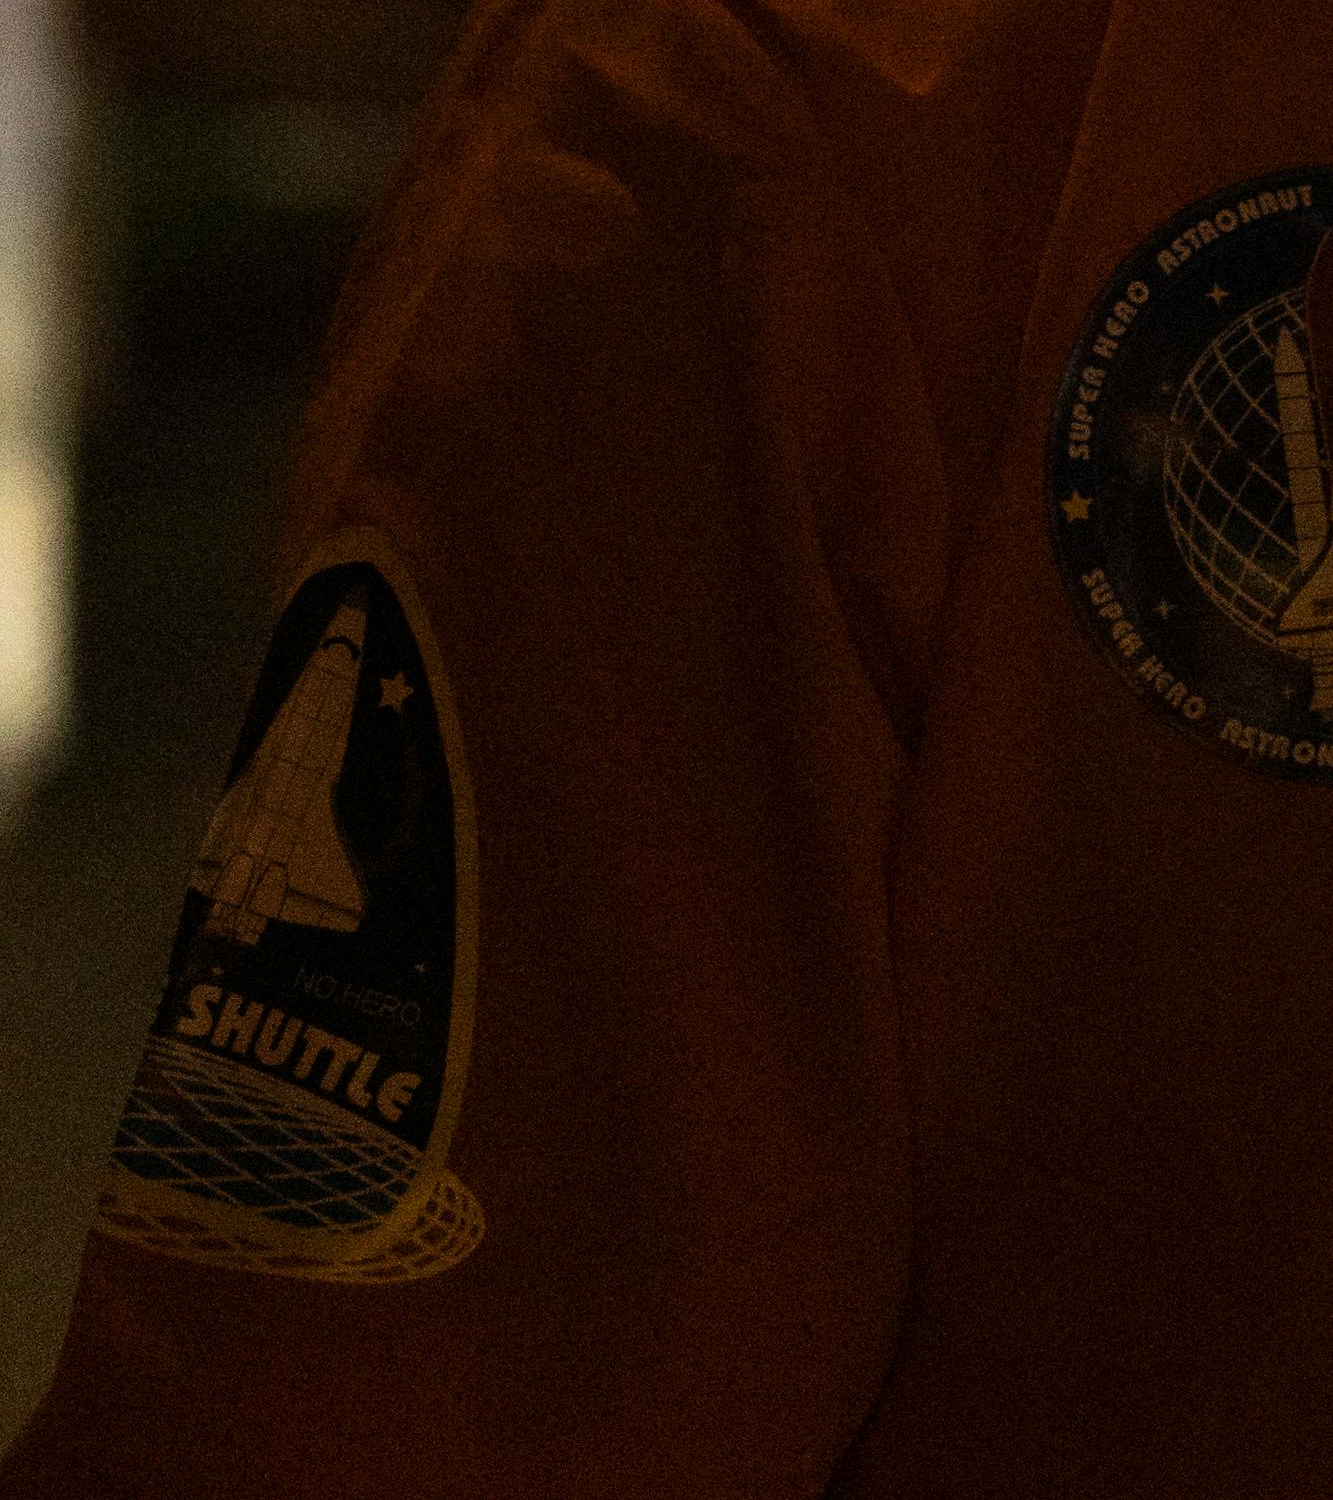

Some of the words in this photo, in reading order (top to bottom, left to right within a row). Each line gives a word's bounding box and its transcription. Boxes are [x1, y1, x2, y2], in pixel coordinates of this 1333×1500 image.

[1068, 365, 1107, 462] SUPER
[1092, 280, 1151, 361] HERO
[1156, 185, 1313, 276] ASTRONAUT
[1081, 568, 1144, 658] SUPER
[1137, 654, 1207, 720] HERO
[176, 983, 424, 1124] SHUTTLE
